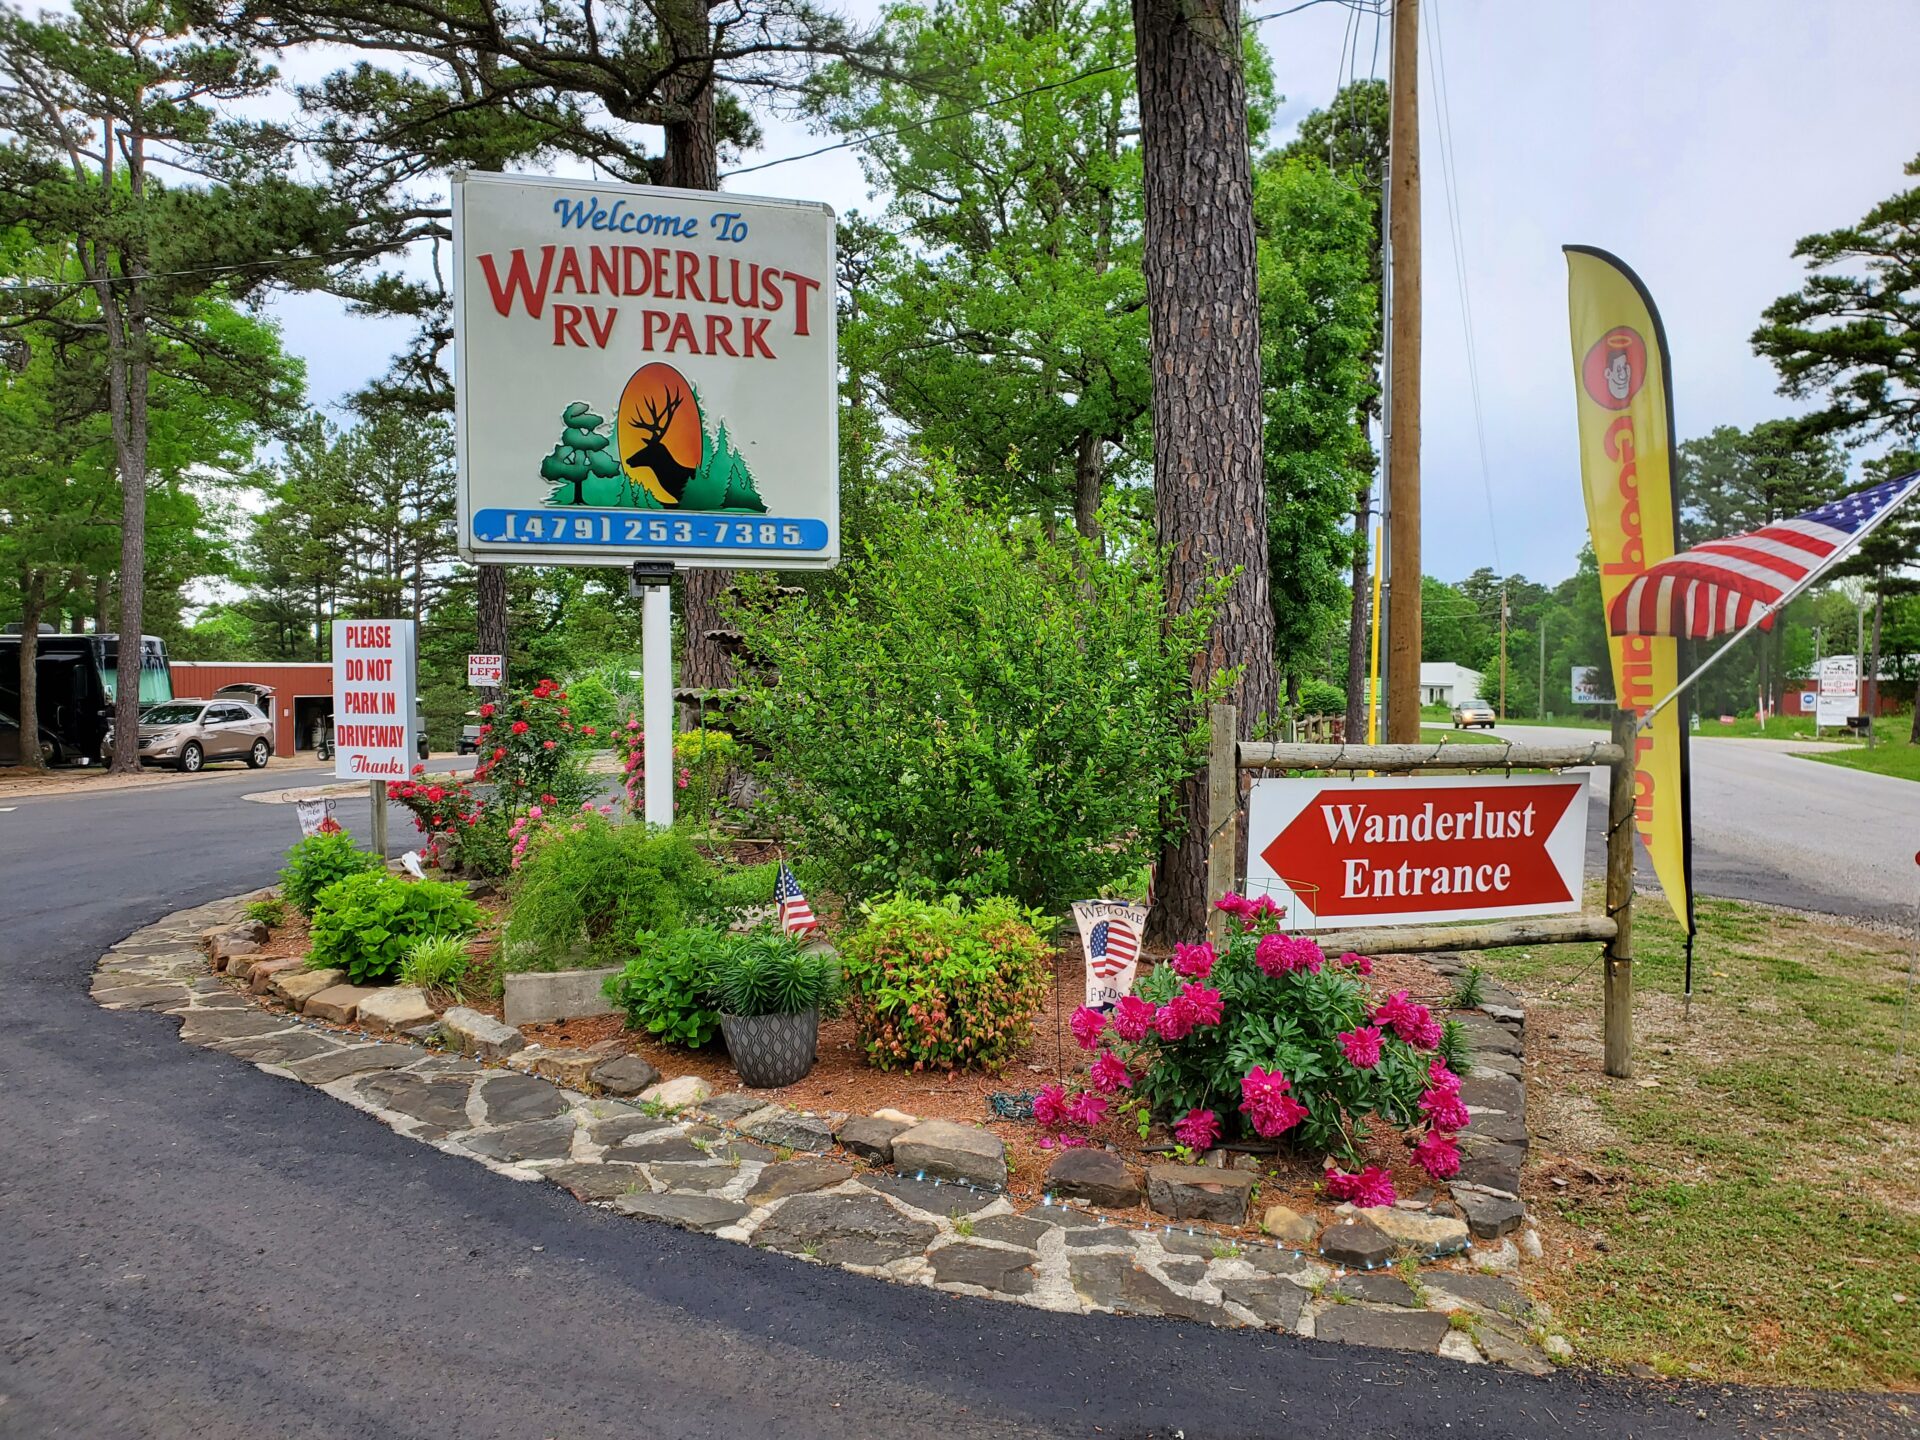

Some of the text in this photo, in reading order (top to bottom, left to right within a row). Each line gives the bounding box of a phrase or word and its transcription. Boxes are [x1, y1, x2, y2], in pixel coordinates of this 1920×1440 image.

[553, 197, 748, 242] Welcome To
[477, 245, 821, 336] WANDERLUST
[552, 303, 777, 359] RV PARK
[625, 519, 802, 546] 253-7385
[346, 626, 391, 648] PLEASE
[345, 659, 392, 681] DO NOT
[469, 656, 501, 665] KEEP
[344, 692, 395, 714] PARK IN
[337, 725, 404, 748] DRIVEWAY
[350, 754, 405, 775] Thanks
[1320, 801, 1537, 845] Wanderlust
[1341, 858, 1512, 898] Entrance
